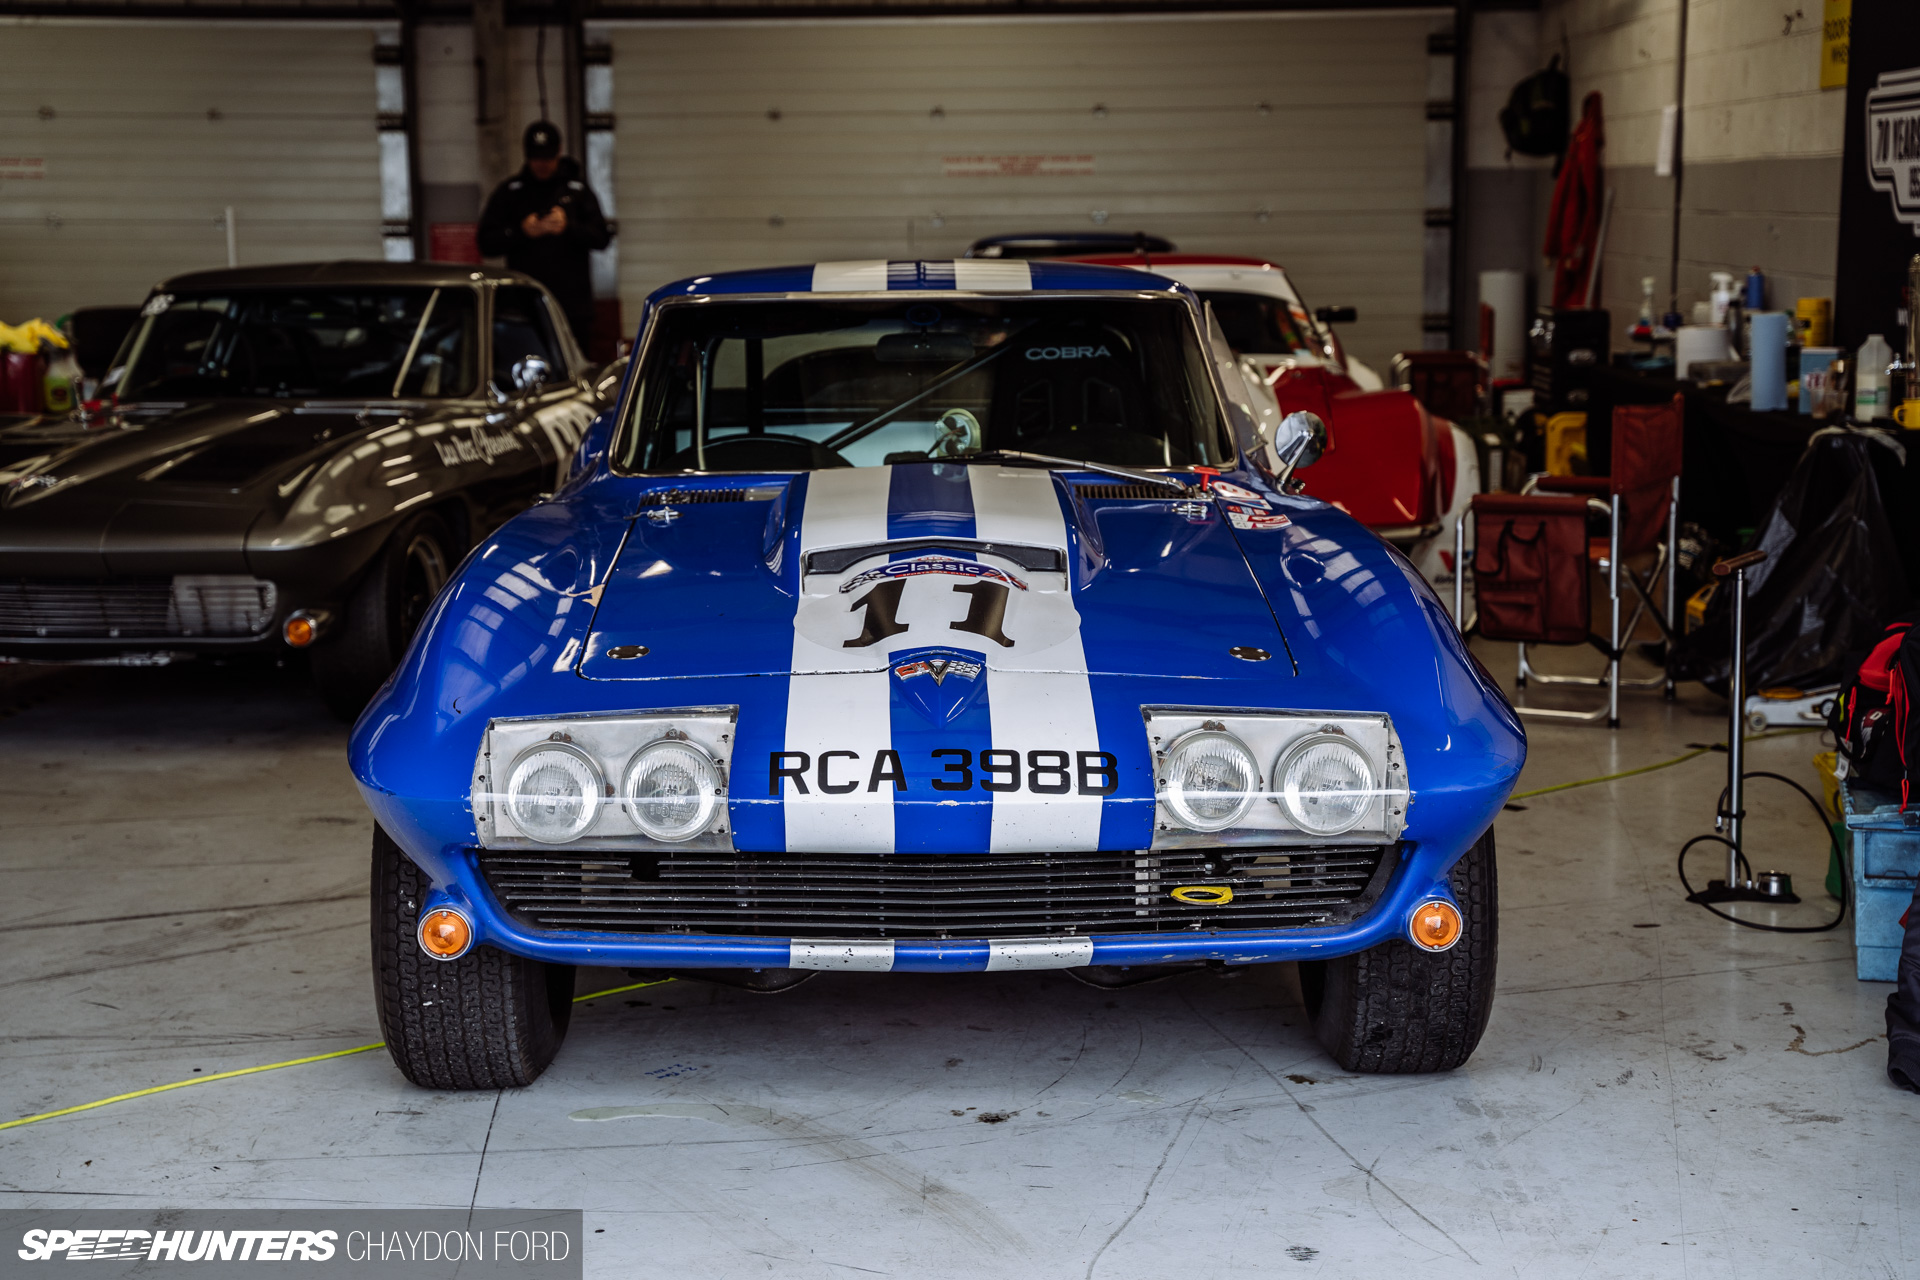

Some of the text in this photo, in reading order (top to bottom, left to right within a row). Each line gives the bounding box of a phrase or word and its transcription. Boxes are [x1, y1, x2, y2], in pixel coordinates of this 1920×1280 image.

[1025, 345, 1111, 360] COBRA
[885, 563, 980, 574] Classic
[842, 578, 1015, 648] 11
[768, 748, 1120, 797] RCA 398B
